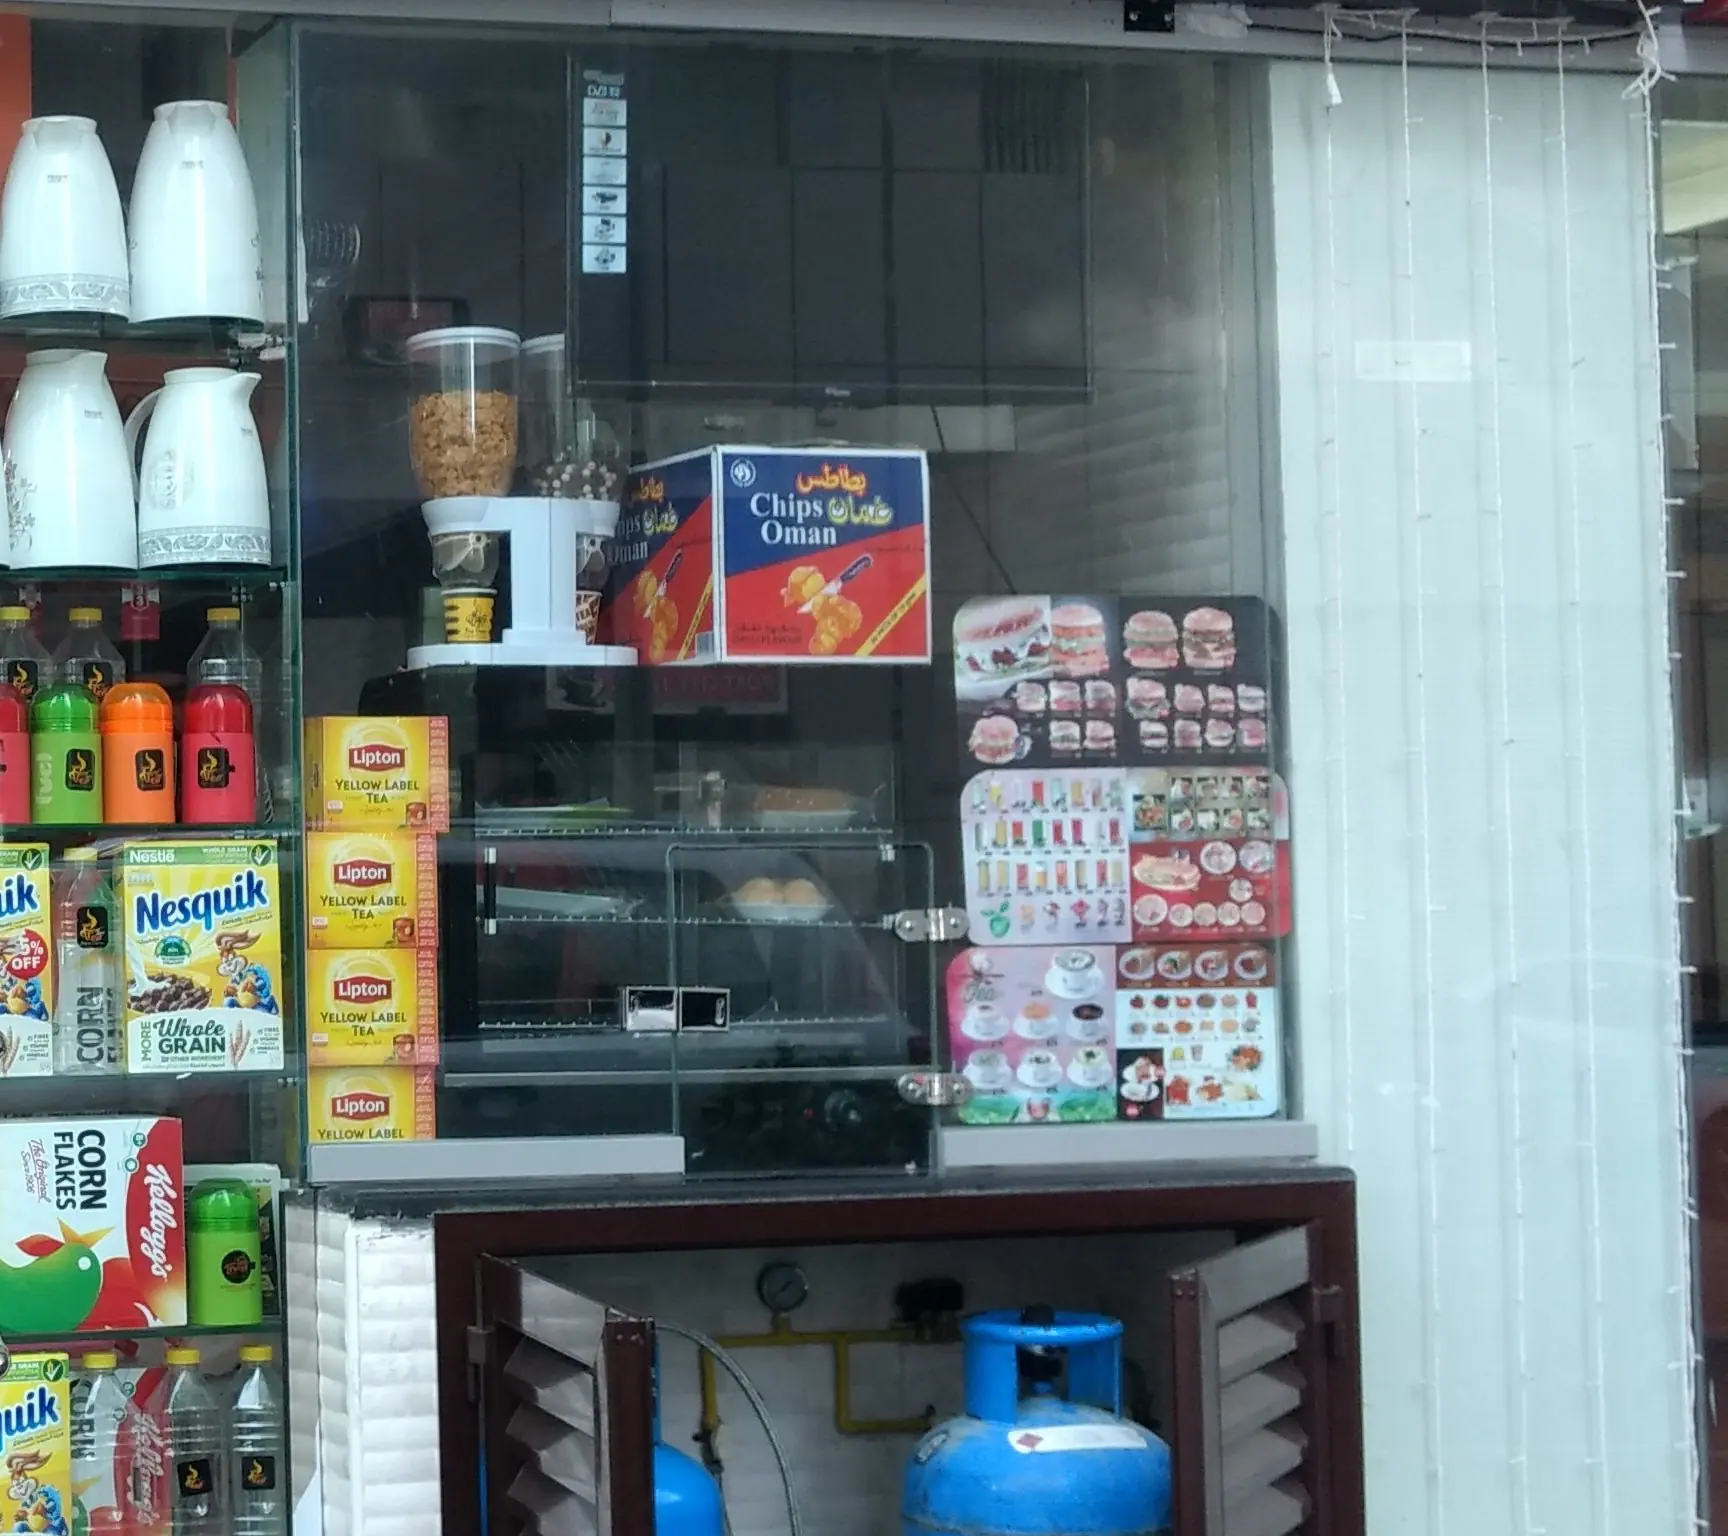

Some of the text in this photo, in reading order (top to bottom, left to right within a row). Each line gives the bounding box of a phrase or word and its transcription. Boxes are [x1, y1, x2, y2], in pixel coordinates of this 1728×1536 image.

[796, 462, 867, 495] بطاطس
[750, 492, 824, 523] Chips
[761, 519, 837, 546] Oman
[353, 749, 401, 766] Lipton
[335, 779, 420, 791] YELLOW LABEL
[365, 792, 389, 805] TEA
[338, 865, 387, 882] Lipton
[136, 869, 268, 935] Nesquik
[320, 895, 408, 907] YELLOW LABEL
[351, 909, 375, 921] TEA
[11, 956, 41, 971] OFF
[338, 982, 388, 999] Lipton
[76, 986, 105, 1064] CORN
[320, 1011, 408, 1024] YELLOW LABEL
[152, 1017, 226, 1037] Whole
[351, 1025, 375, 1037] TEA
[140, 1021, 152, 1062] MORE
[158, 1037, 226, 1055] GRAIN
[335, 1098, 386, 1115] Lipton
[318, 1128, 405, 1140] YELLOW LABEL
[30, 1138, 52, 1203] The Original
[53, 1131, 78, 1211] FLAKES
[76, 1128, 108, 1211] CORN
[139, 1163, 178, 1283] Kellogg's
